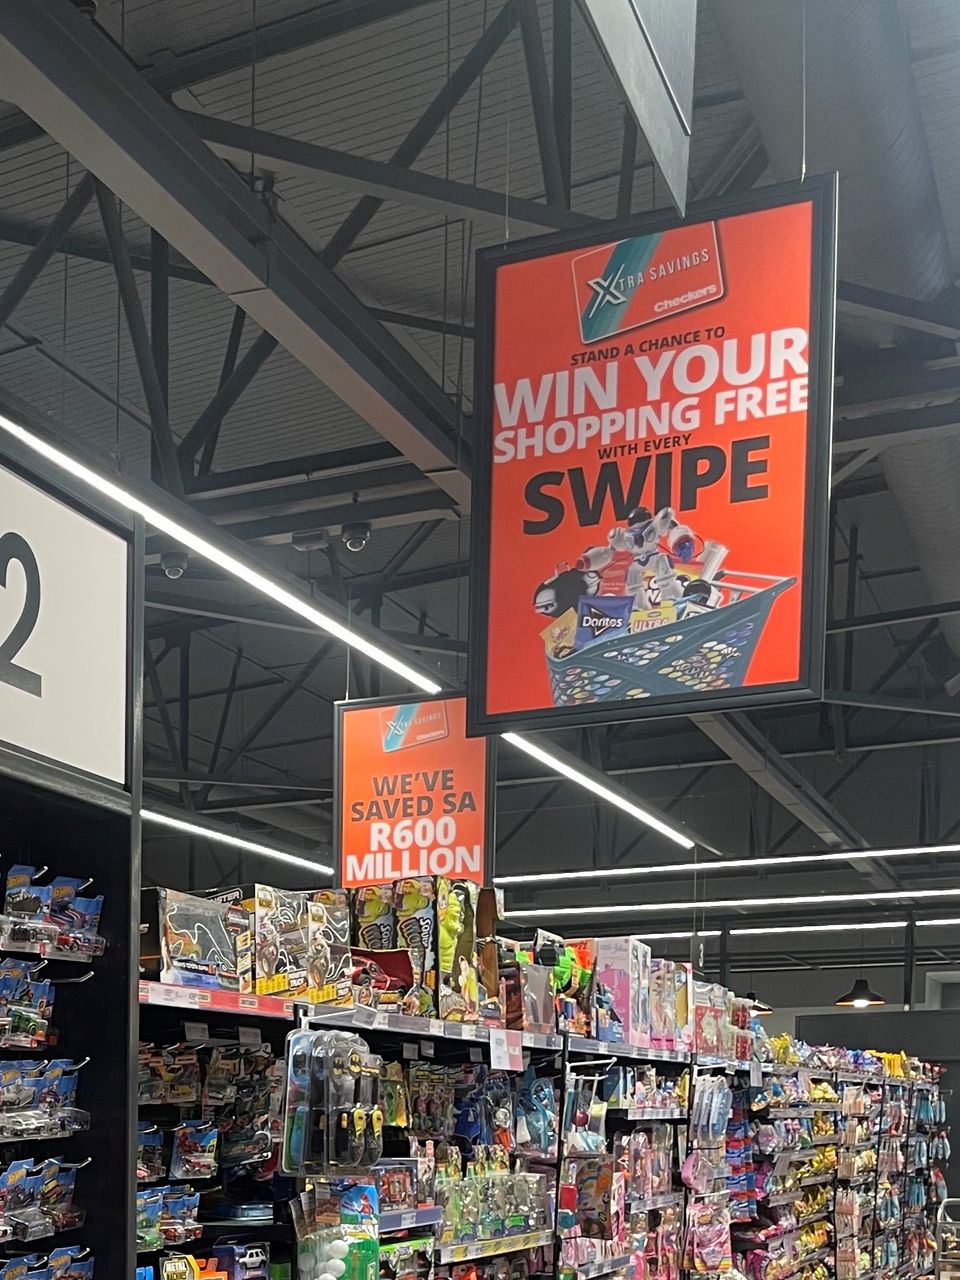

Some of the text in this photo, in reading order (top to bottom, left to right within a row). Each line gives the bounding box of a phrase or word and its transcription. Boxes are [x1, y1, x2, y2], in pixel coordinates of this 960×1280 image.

[649, 248, 710, 281] SAVINGS
[571, 326, 726, 366] STAND A CHANCE TO
[494, 327, 809, 429] WIN YOUR
[494, 376, 809, 463] SHOPPING FREE
[598, 433, 693, 459] WITH EVERY
[522, 435, 771, 536] SWIPE
[583, 616, 623, 629] Doritos
[373, 769, 455, 797] WE'VE
[351, 791, 477, 822] SAVED SA
[370, 816, 457, 852] R600
[346, 845, 481, 882] MILLION
[699, 943, 704, 968] 3
